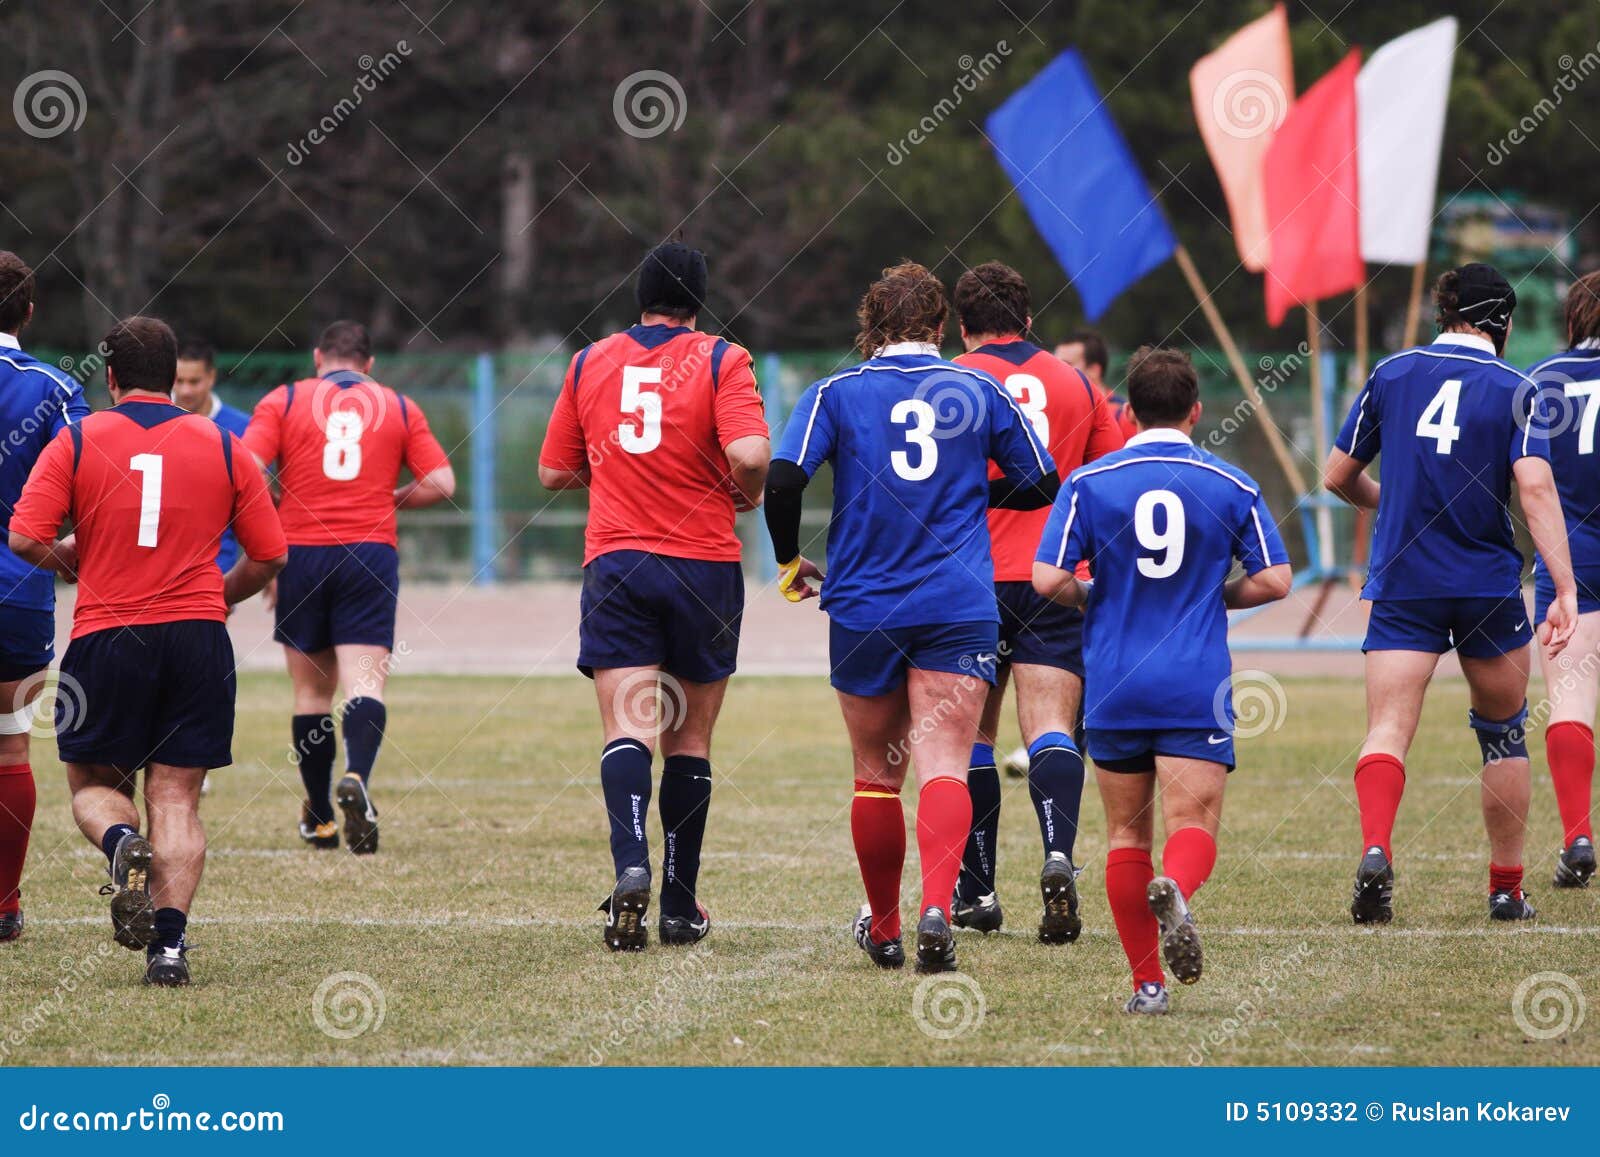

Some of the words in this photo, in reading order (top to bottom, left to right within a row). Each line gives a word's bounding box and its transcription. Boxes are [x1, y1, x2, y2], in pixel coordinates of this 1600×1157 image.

[322, 410, 364, 481] 8
[618, 365, 662, 454] 5
[890, 398, 938, 481] 3
[1415, 380, 1461, 455] 4
[1563, 379, 1600, 455] 7
[129, 453, 163, 548] 1
[1134, 489, 1186, 579] 9
[630, 793, 644, 841] WESTPORT
[974, 829, 989, 876] WESTPORT
[1041, 798, 1055, 843] WESTPORT
[667, 831, 677, 884] WESTPORT
